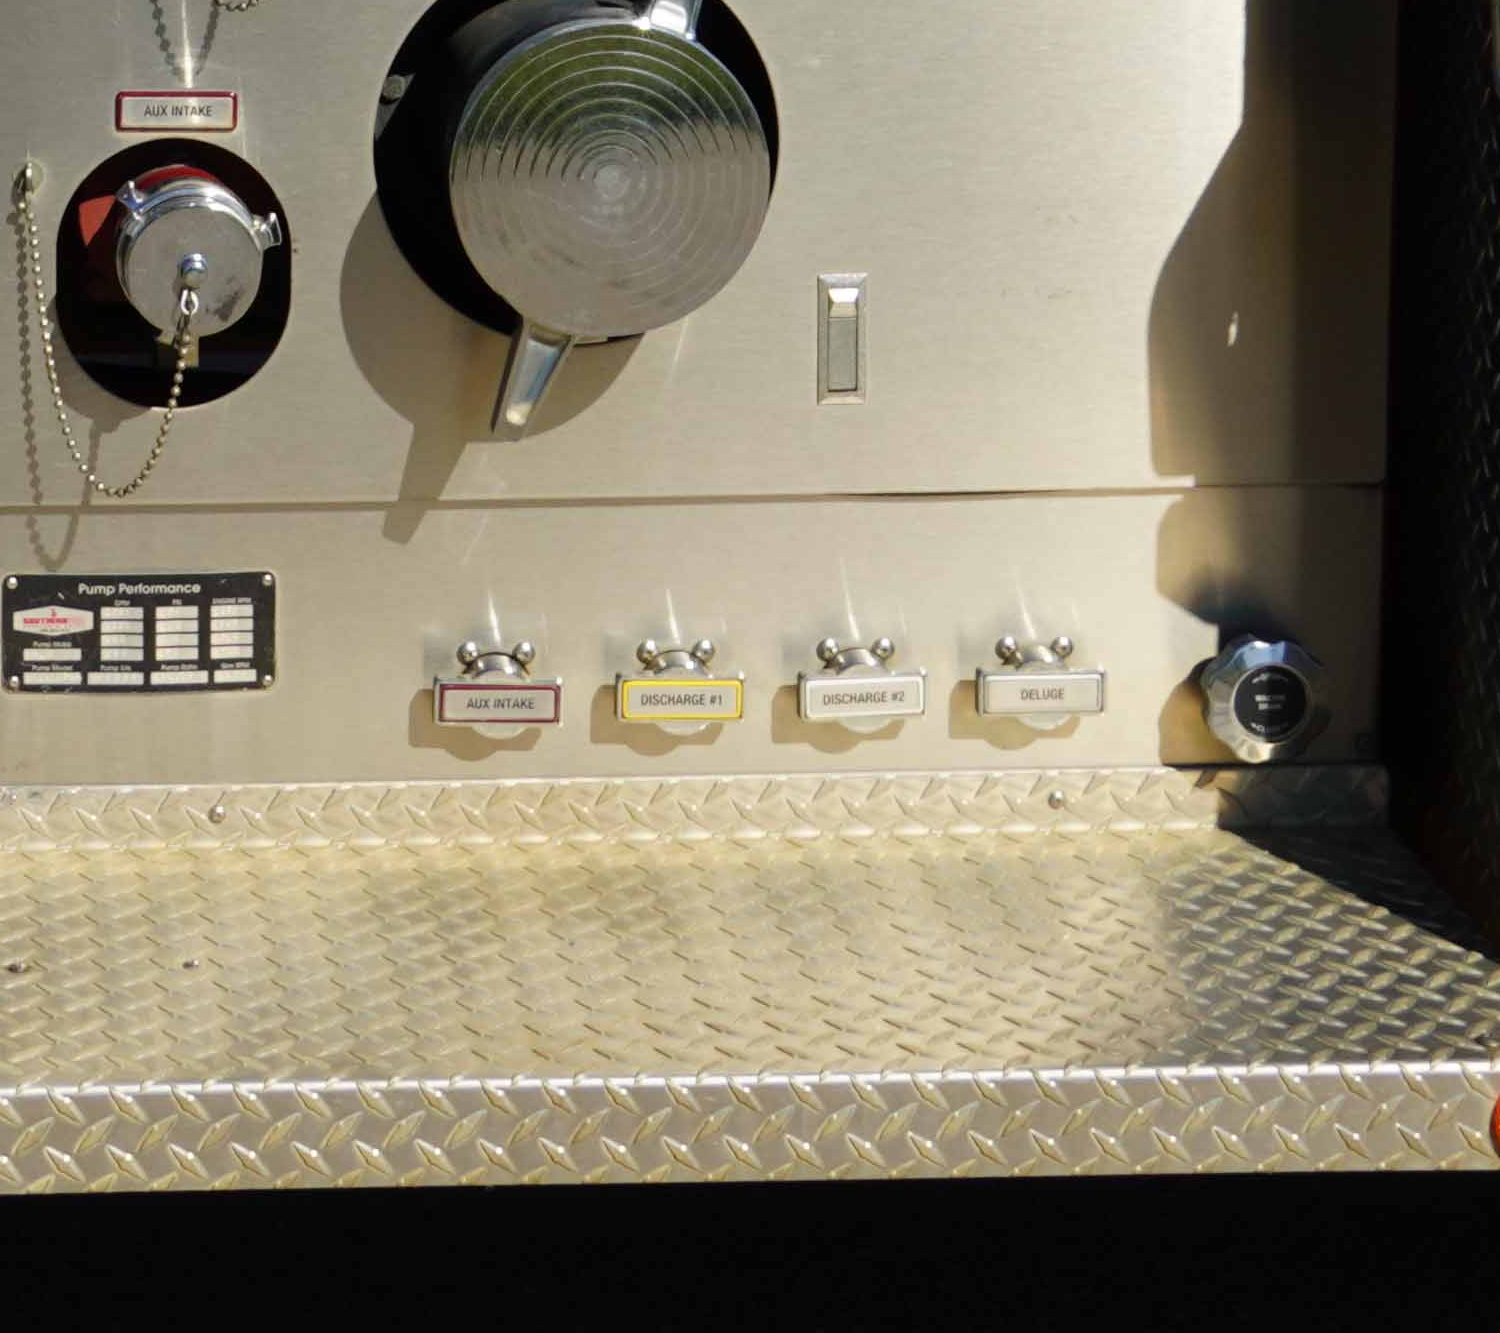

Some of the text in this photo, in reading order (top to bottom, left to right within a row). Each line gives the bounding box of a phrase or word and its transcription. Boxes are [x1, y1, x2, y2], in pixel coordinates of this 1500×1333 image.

[144, 105, 214, 117] AUX INTAKE
[78, 583, 201, 595] Pump Performance
[641, 693, 723, 707] DISCHARGE #1
[822, 690, 905, 705] DISCHARGE #2
[1020, 687, 1065, 701] DELUGE
[466, 697, 536, 711] AUX INTAKE
